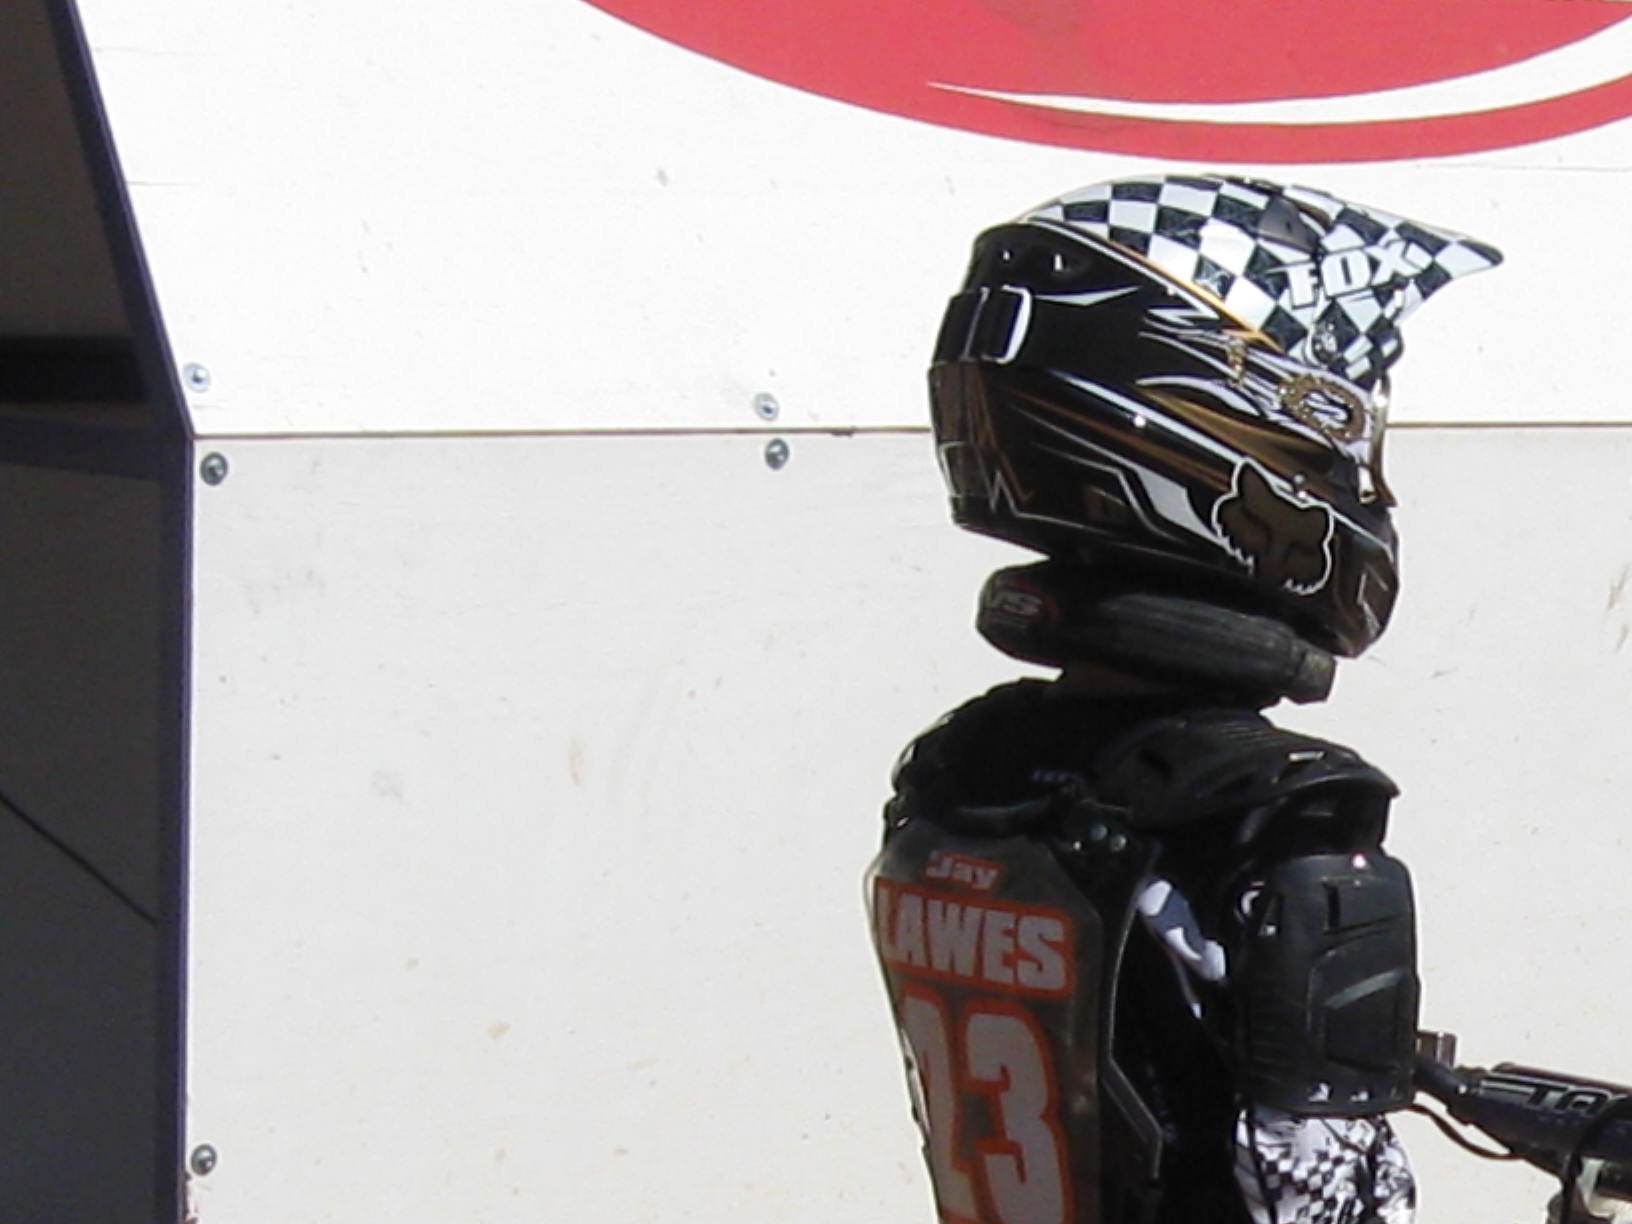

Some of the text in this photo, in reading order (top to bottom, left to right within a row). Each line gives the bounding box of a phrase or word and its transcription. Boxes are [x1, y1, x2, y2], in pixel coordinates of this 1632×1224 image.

[1267, 239, 1433, 310] FOX
[926, 851, 998, 889] Jay
[877, 888, 1068, 991] LAWES
